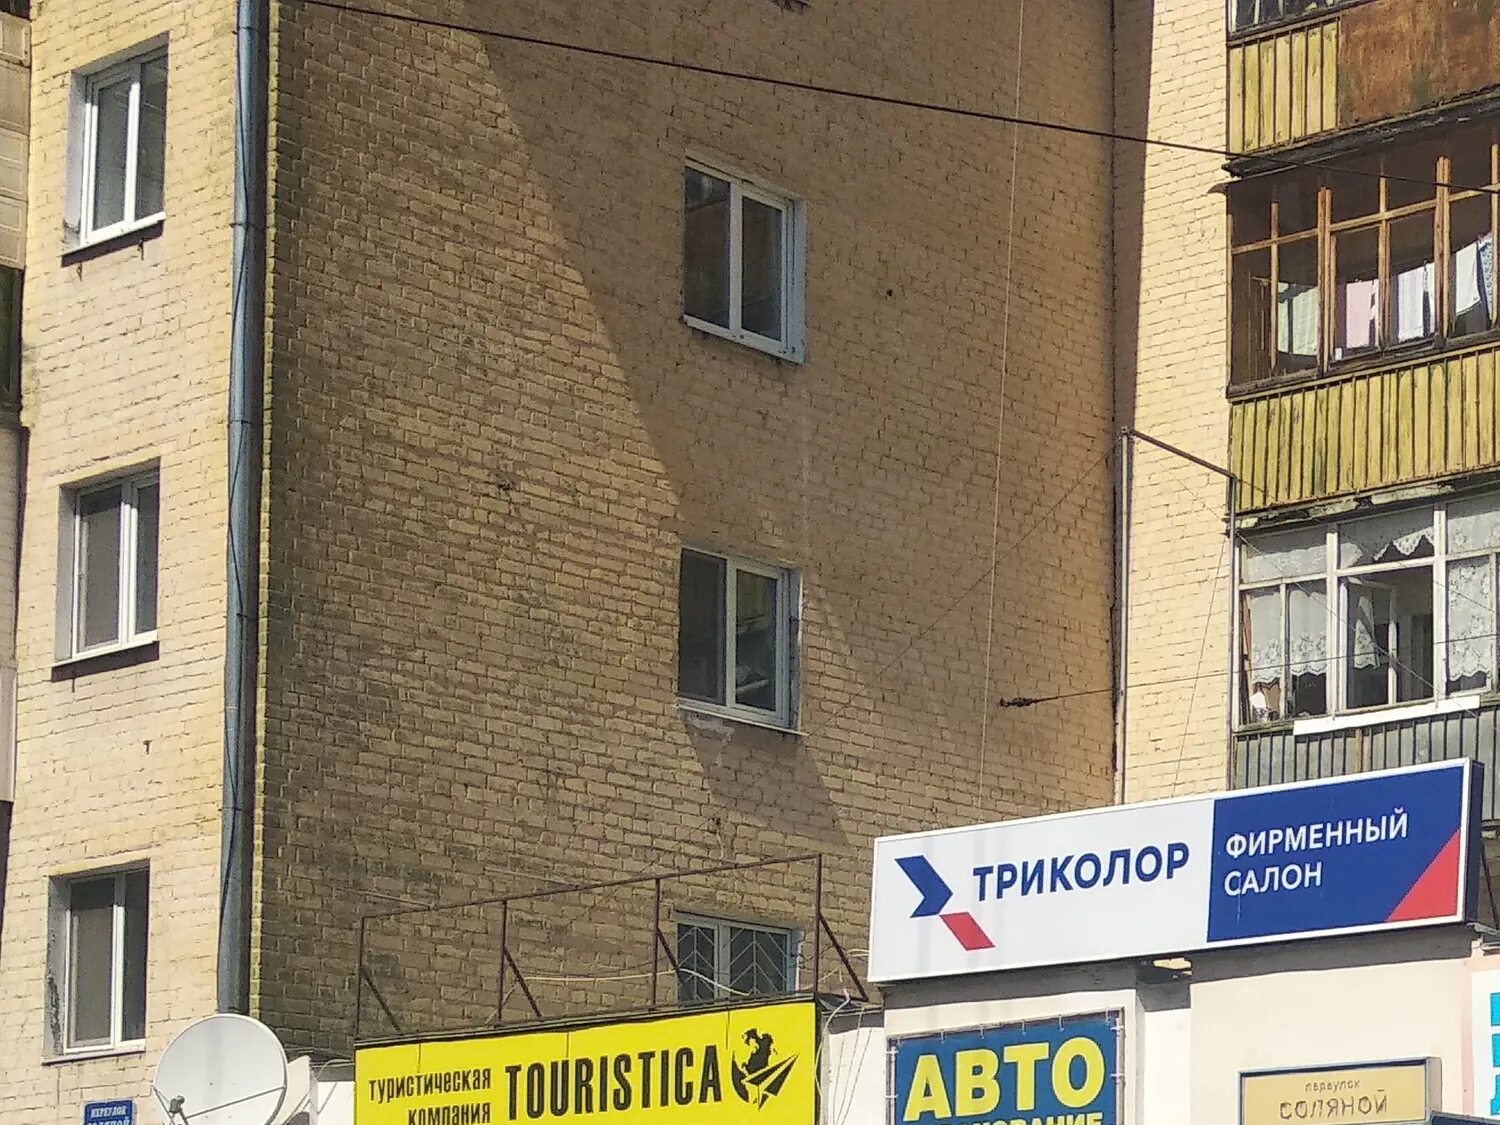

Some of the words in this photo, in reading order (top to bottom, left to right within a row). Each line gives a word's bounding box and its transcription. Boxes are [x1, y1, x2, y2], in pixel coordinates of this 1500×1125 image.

[1225, 806, 1408, 859] ФИРМЕННЫЙ
[972, 841, 1190, 902] ТРИКОЛОР
[1225, 861, 1323, 896] САЛОН
[369, 1067, 491, 1104] туристическая
[505, 1045, 721, 1121] TOURISTICA
[903, 1036, 1105, 1122] АВТО
[1305, 1080, 1360, 1093] переулок
[1280, 1089, 1387, 1120] СОЛЯНОЙ
